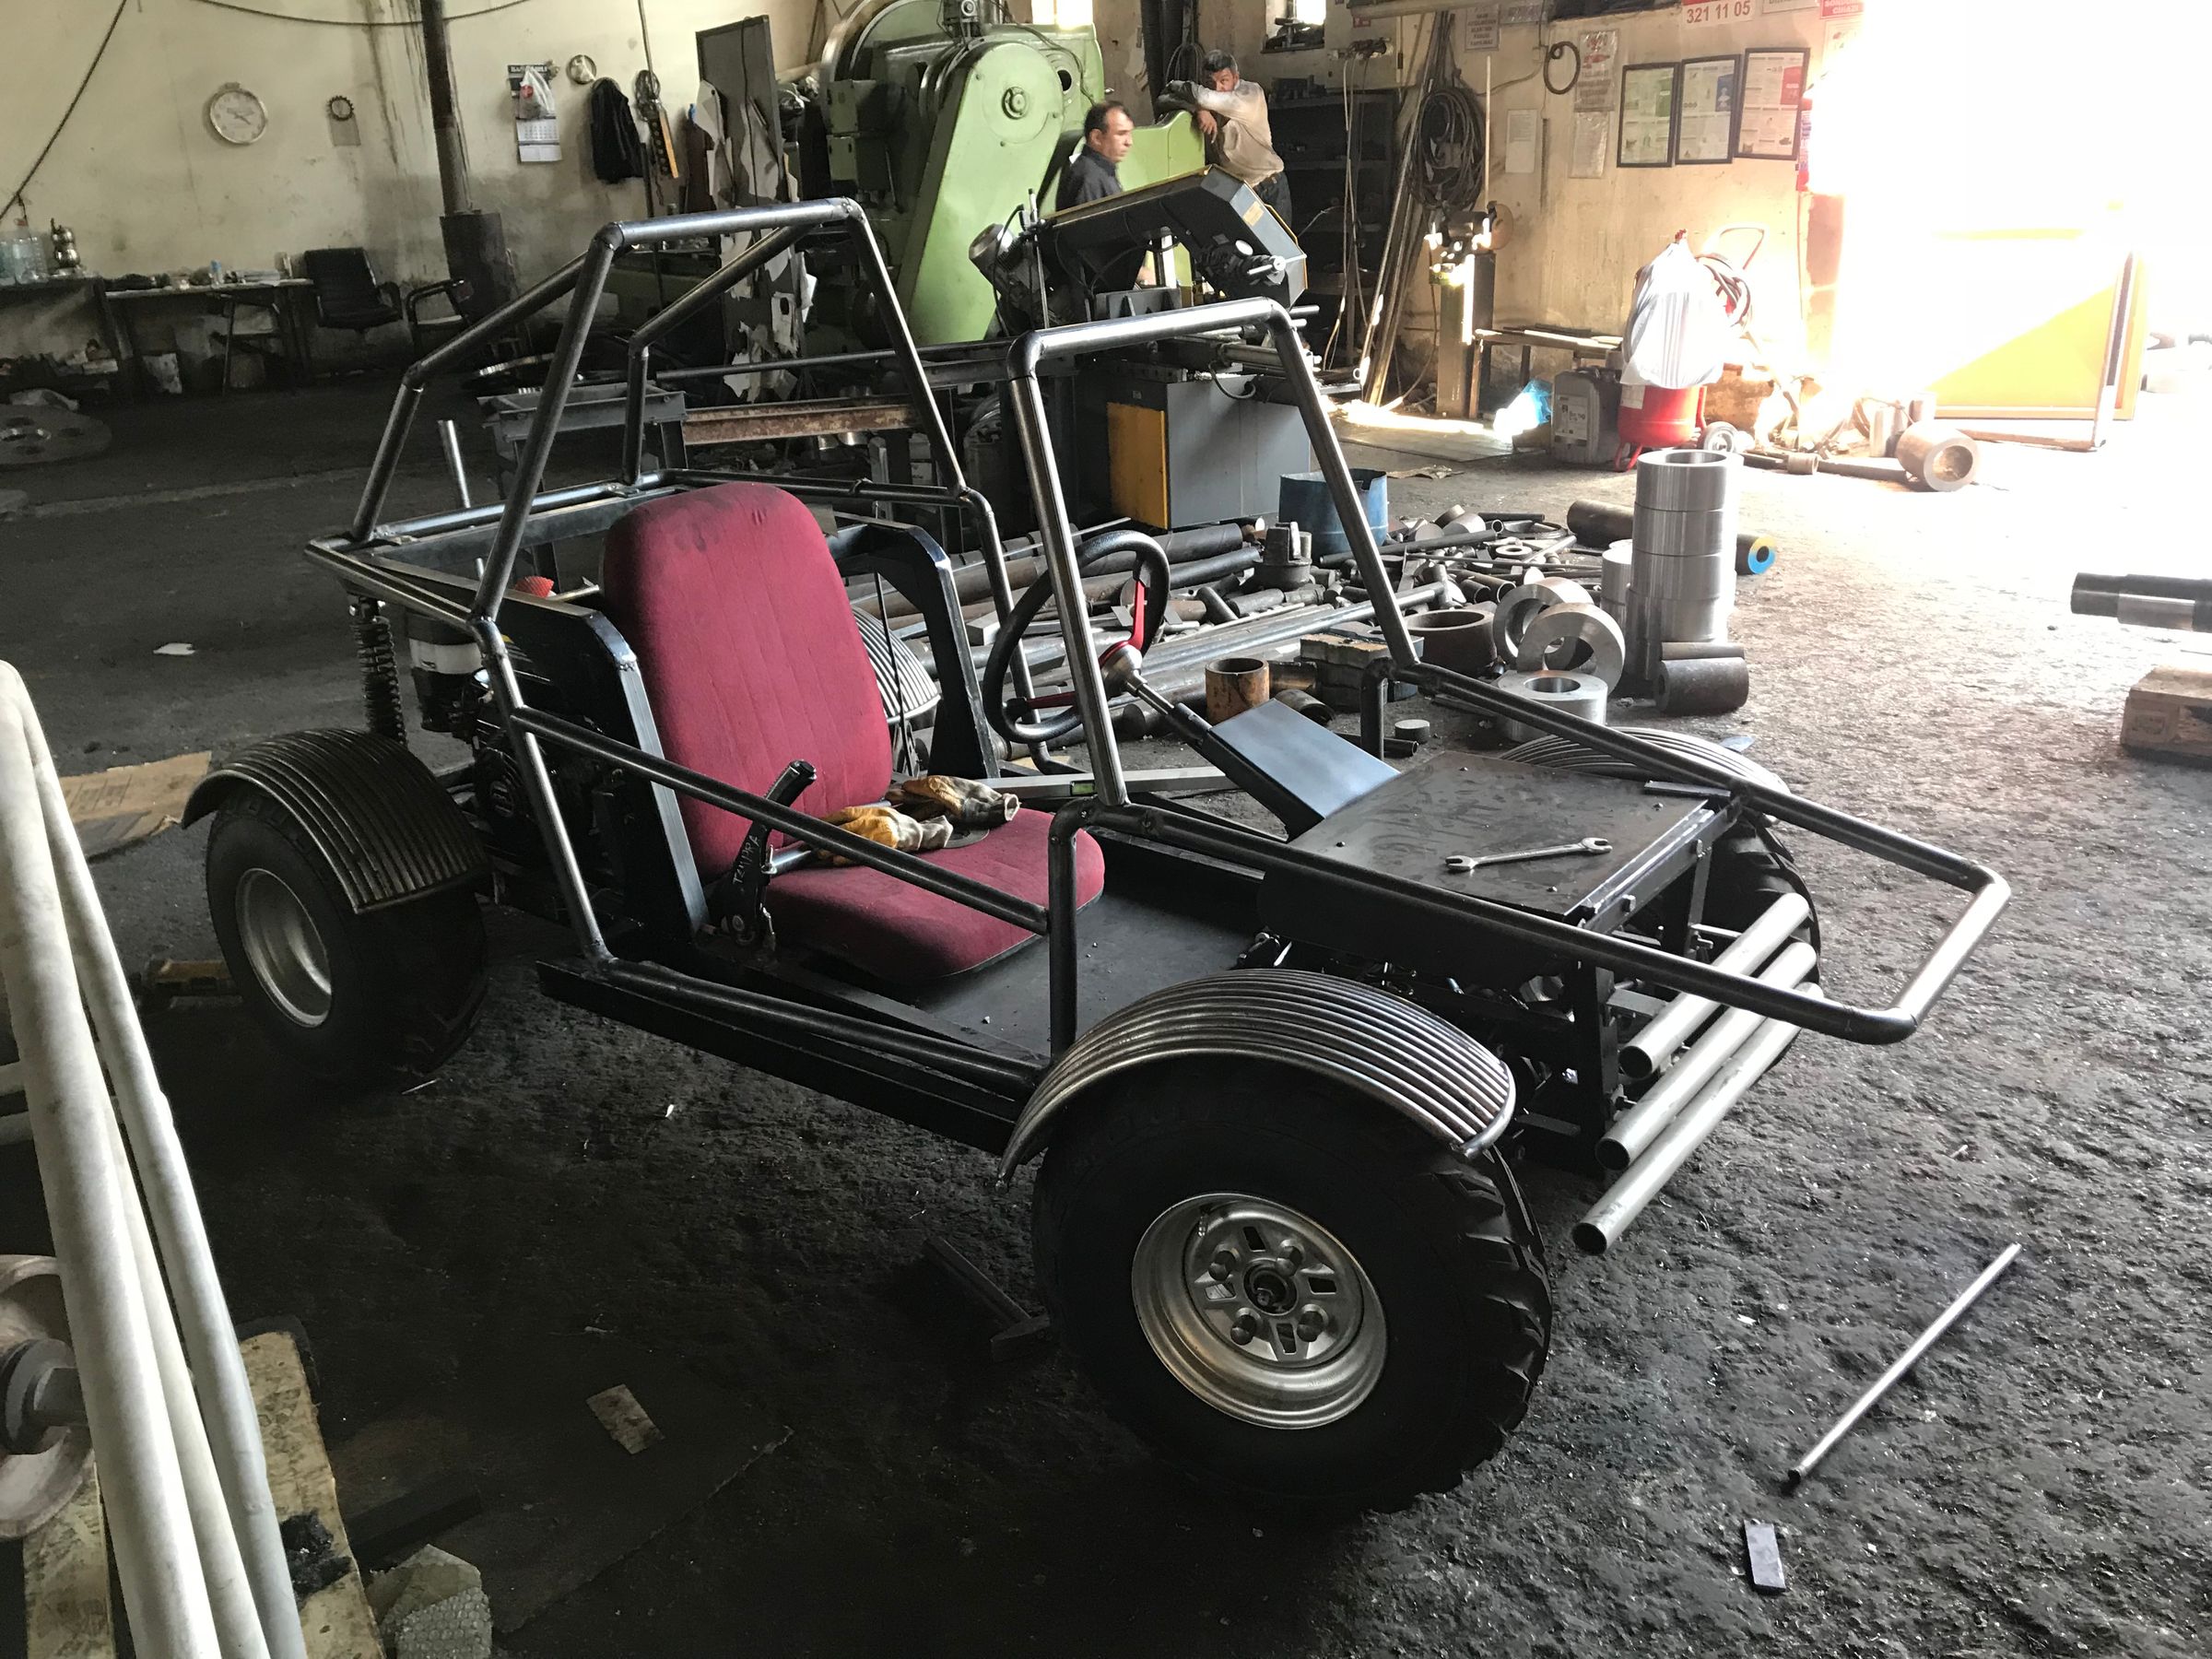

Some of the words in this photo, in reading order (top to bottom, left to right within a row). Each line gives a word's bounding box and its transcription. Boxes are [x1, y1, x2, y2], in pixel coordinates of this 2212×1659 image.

[1687, 6, 1709, 23] 321
[1715, 3, 1729, 19] 11
[1734, 0, 1750, 17] 05
[732, 834, 760, 885] TEMPRA
